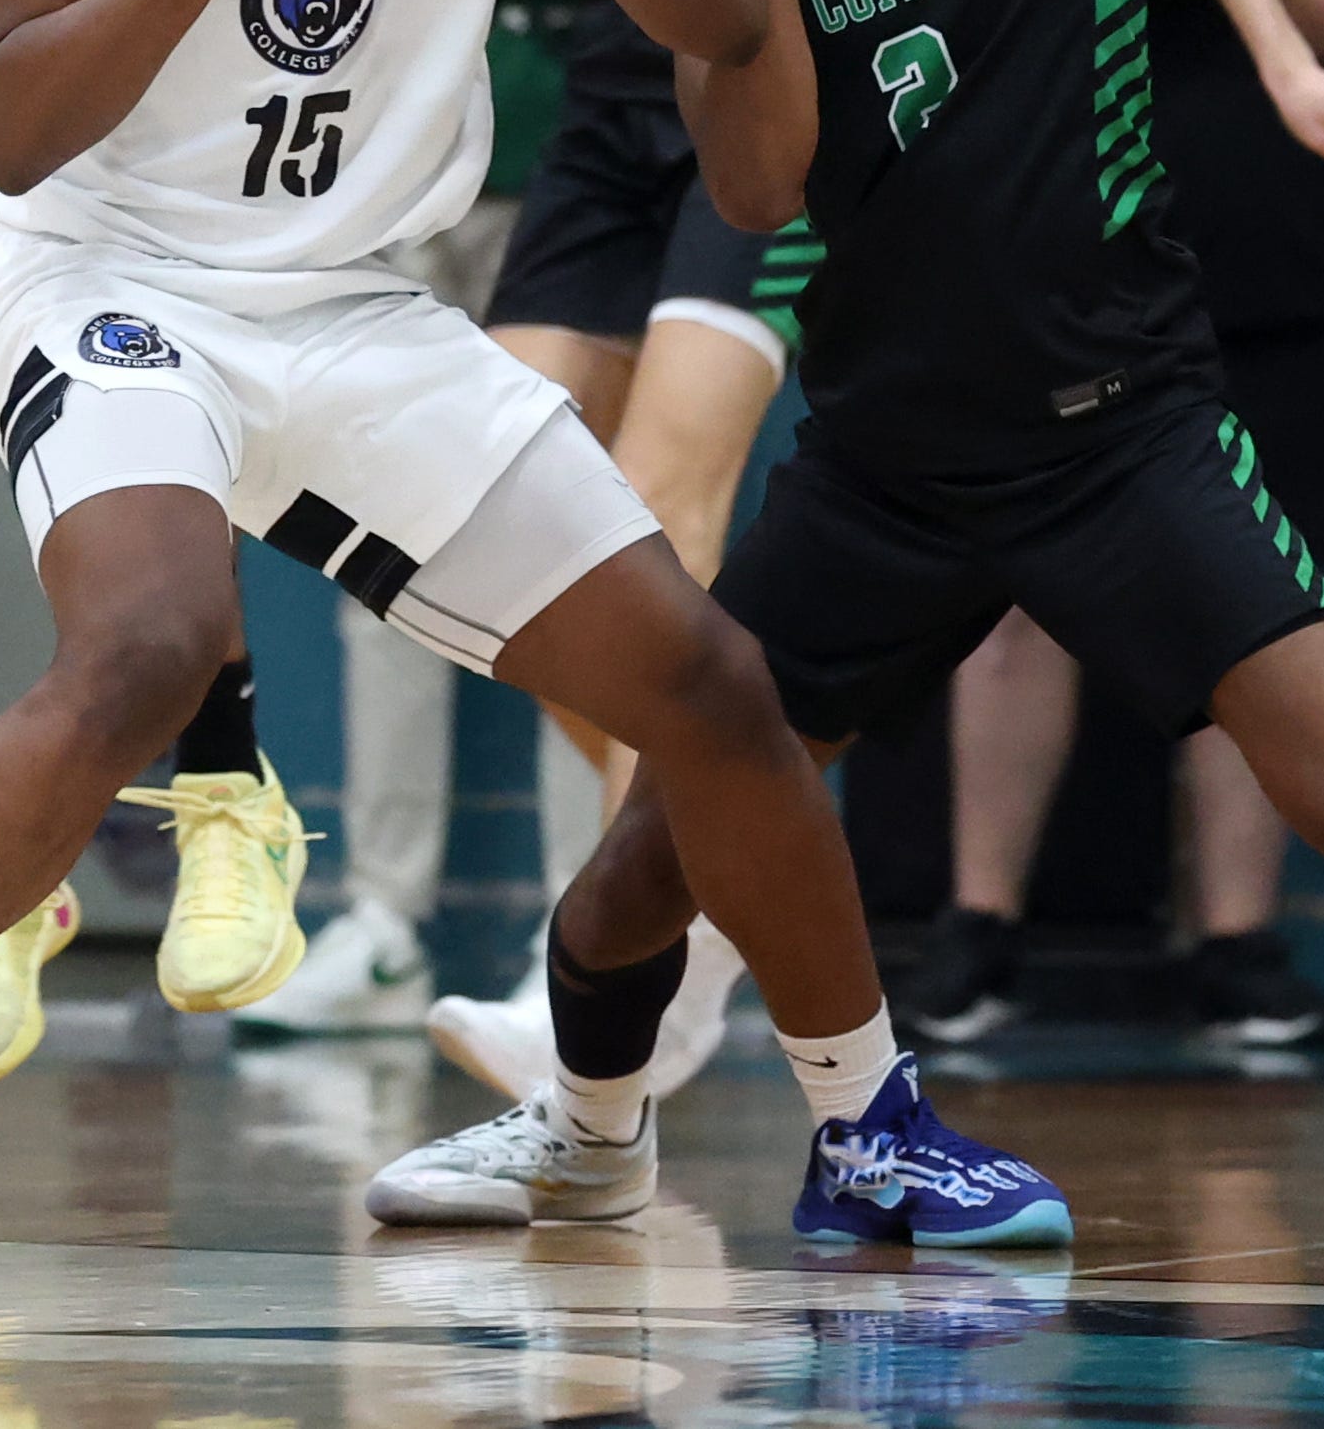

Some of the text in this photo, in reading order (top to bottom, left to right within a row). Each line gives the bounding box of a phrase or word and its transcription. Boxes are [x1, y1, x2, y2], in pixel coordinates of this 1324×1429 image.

[250, 21, 331, 70] COLLEGE
[871, 23, 959, 153] 2
[242, 89, 351, 198] 15
